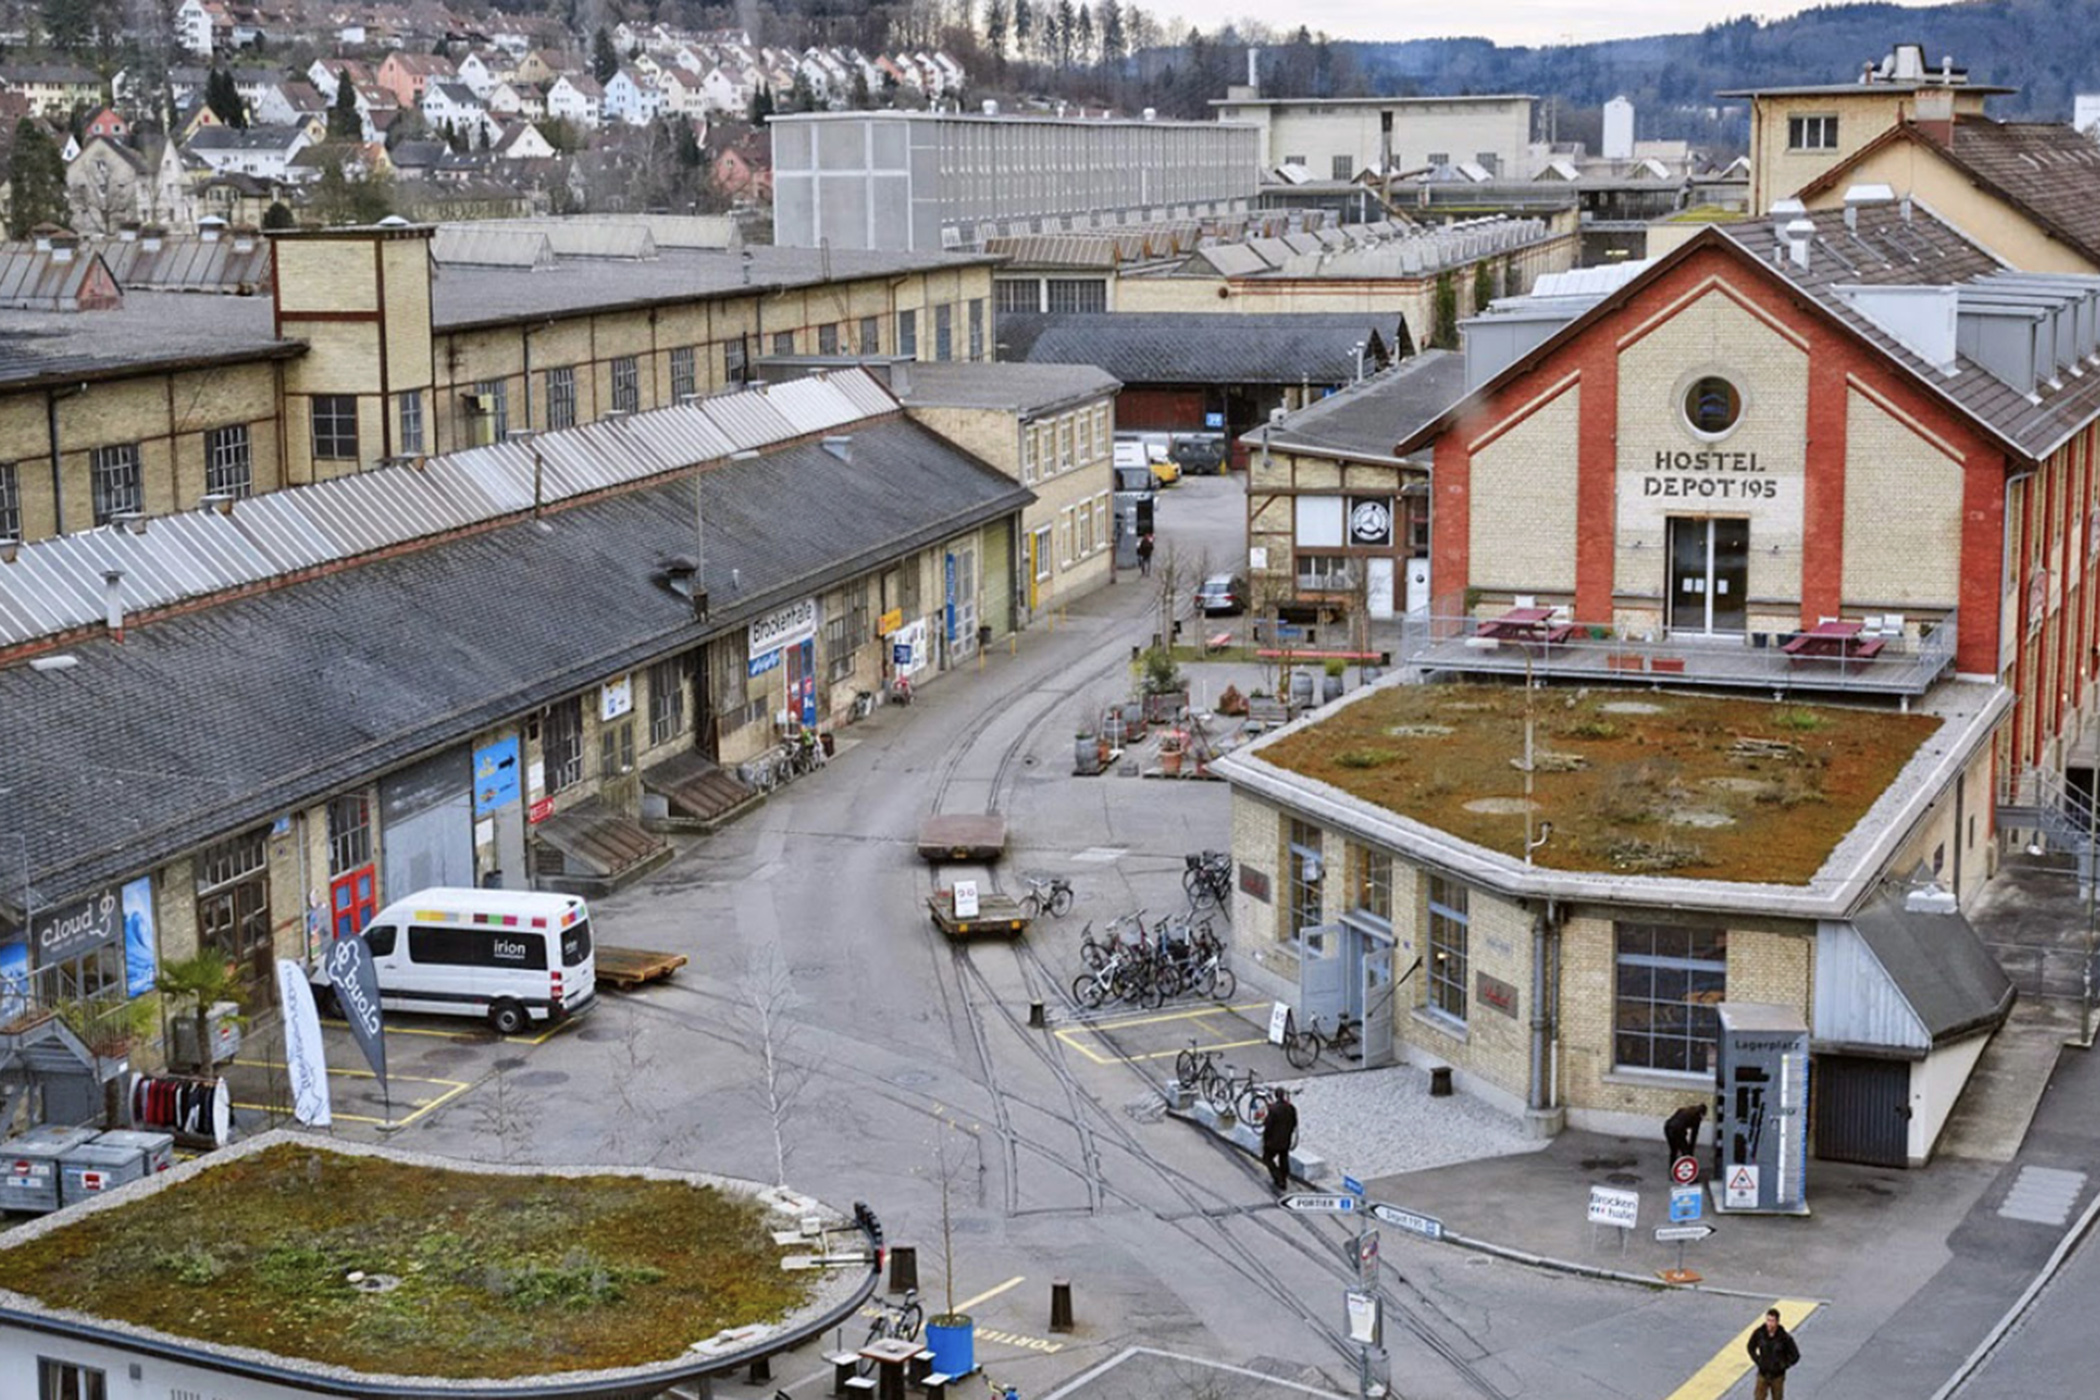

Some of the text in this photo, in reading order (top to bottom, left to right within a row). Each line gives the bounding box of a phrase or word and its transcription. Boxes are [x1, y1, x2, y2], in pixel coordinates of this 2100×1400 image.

[1655, 451, 1766, 472] HOSTEL
[1644, 477, 1777, 498] DEPOT 195
[41, 902, 94, 947] cloud
[494, 939, 526, 955] irion
[1735, 1039, 1800, 1052] Lagerplatz
[1296, 1198, 1335, 1208] PORTIER
[1590, 1193, 1637, 1209] Brocken
